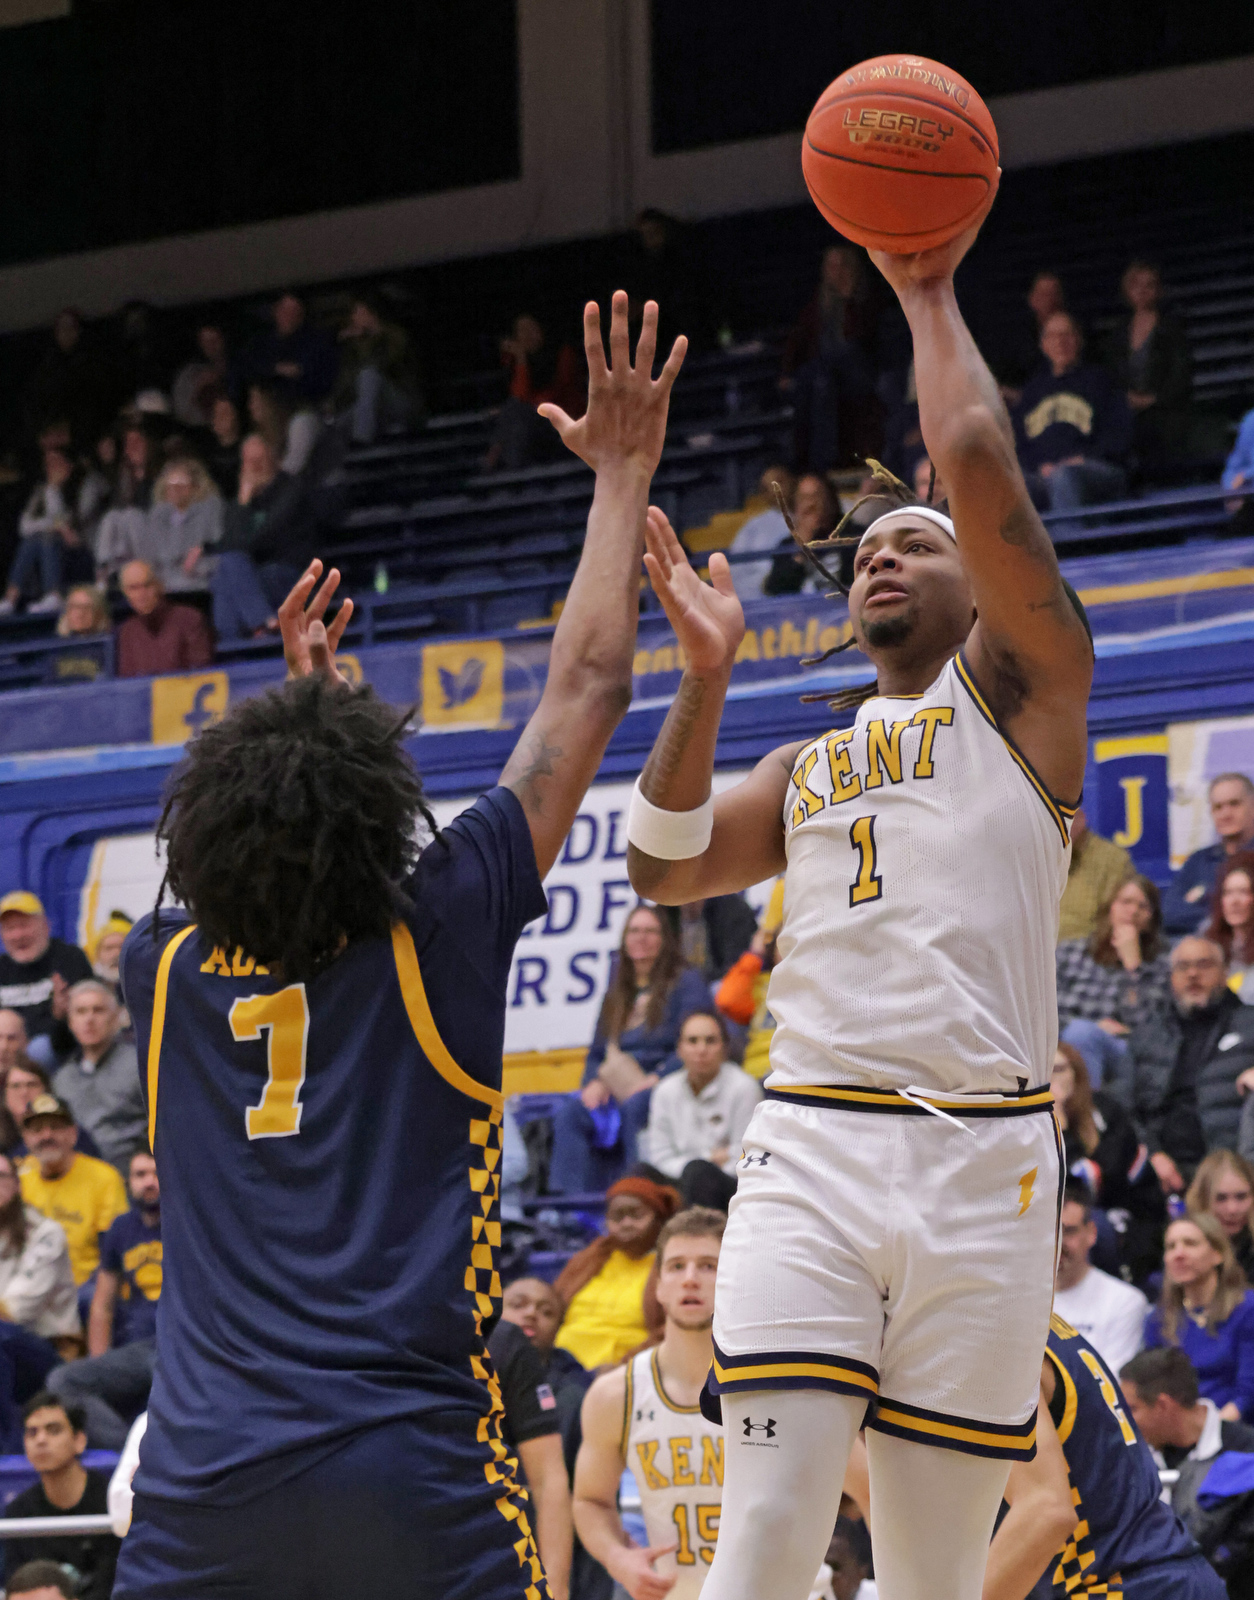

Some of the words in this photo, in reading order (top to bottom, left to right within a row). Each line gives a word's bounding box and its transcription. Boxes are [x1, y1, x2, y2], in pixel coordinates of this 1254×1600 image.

[843, 109, 954, 141] LEGACY
[792, 707, 955, 830] KENT
[1113, 776, 1148, 848] J
[849, 815, 883, 908] 1
[229, 982, 310, 1140] 7
[636, 1436, 725, 1491] KEN
[672, 1503, 723, 1566] 15
